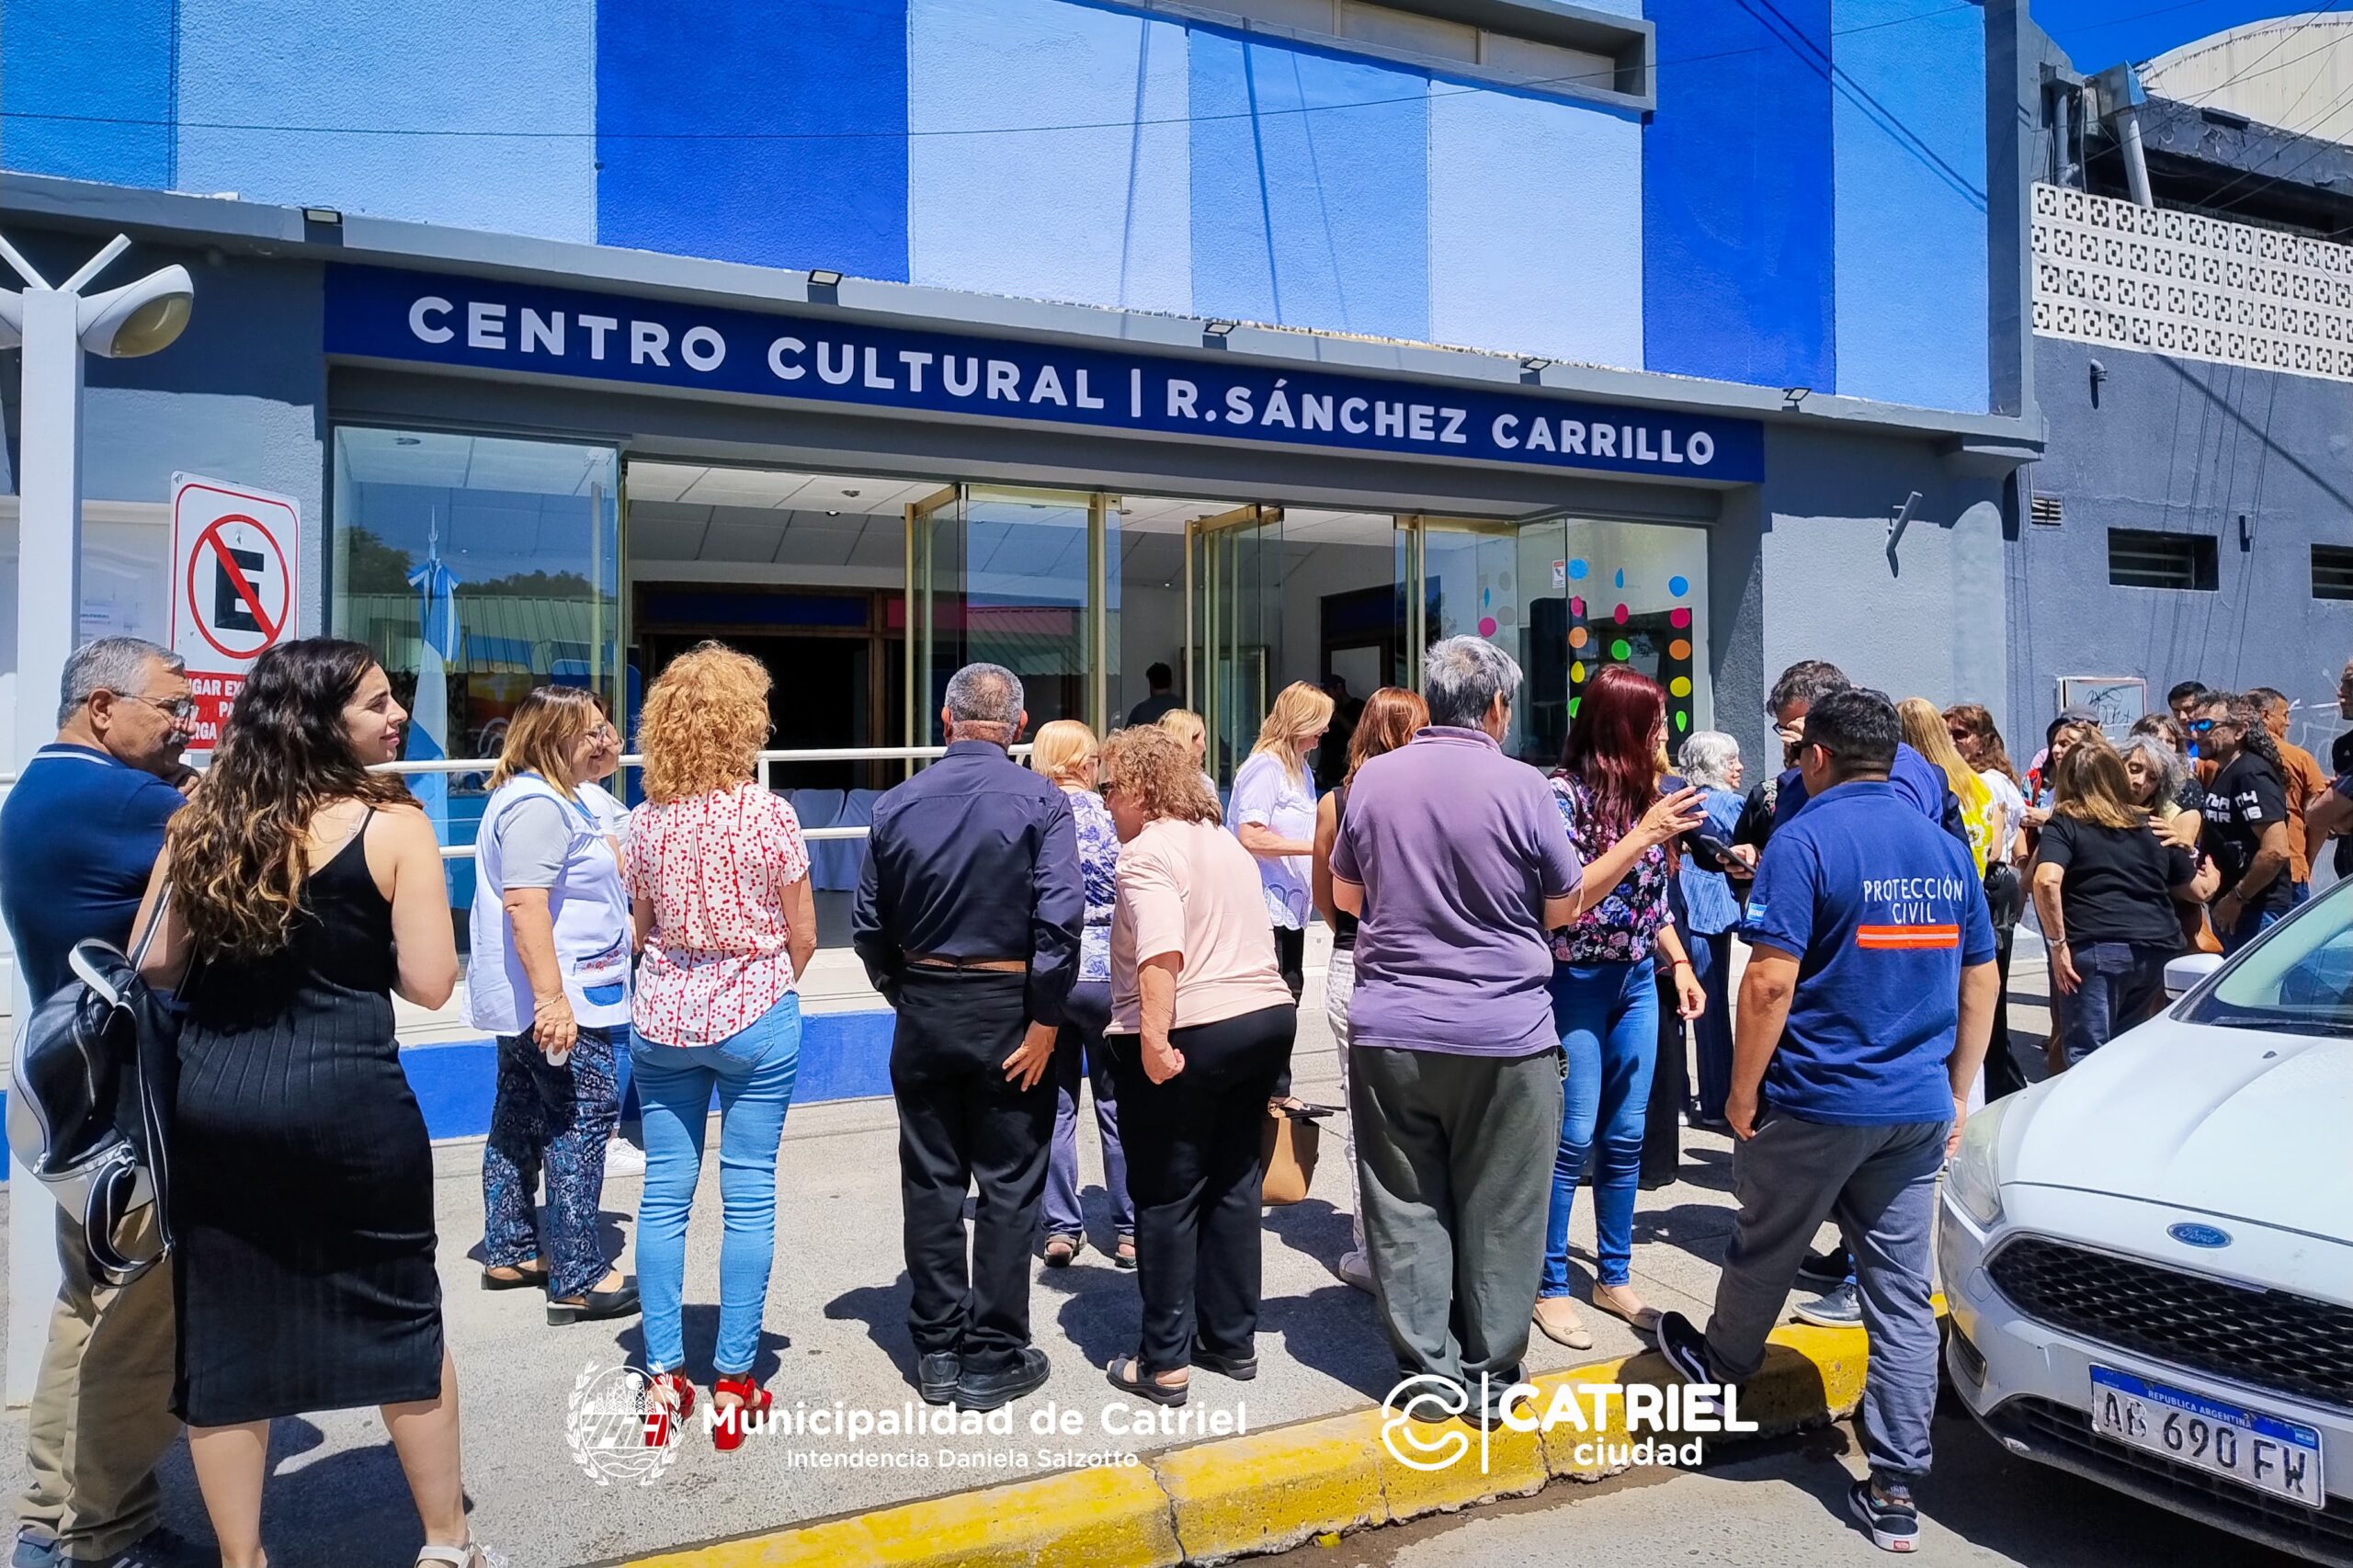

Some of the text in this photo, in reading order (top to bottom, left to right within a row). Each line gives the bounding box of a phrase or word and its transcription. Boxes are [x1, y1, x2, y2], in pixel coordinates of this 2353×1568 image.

[409, 296, 726, 372] CENTRO
[767, 336, 1104, 409] CULTURAL
[1167, 378, 1467, 444] R.SÁNCHEZ
[1492, 414, 1714, 465] CARRILLO
[1863, 873, 1963, 903] PROTECCIÓN
[1892, 902, 1936, 925] CIVIL
[2148, 1389, 2252, 1430] REPUBLICA ARGENTINA
[2103, 1392, 2307, 1494] AB 690 FW
